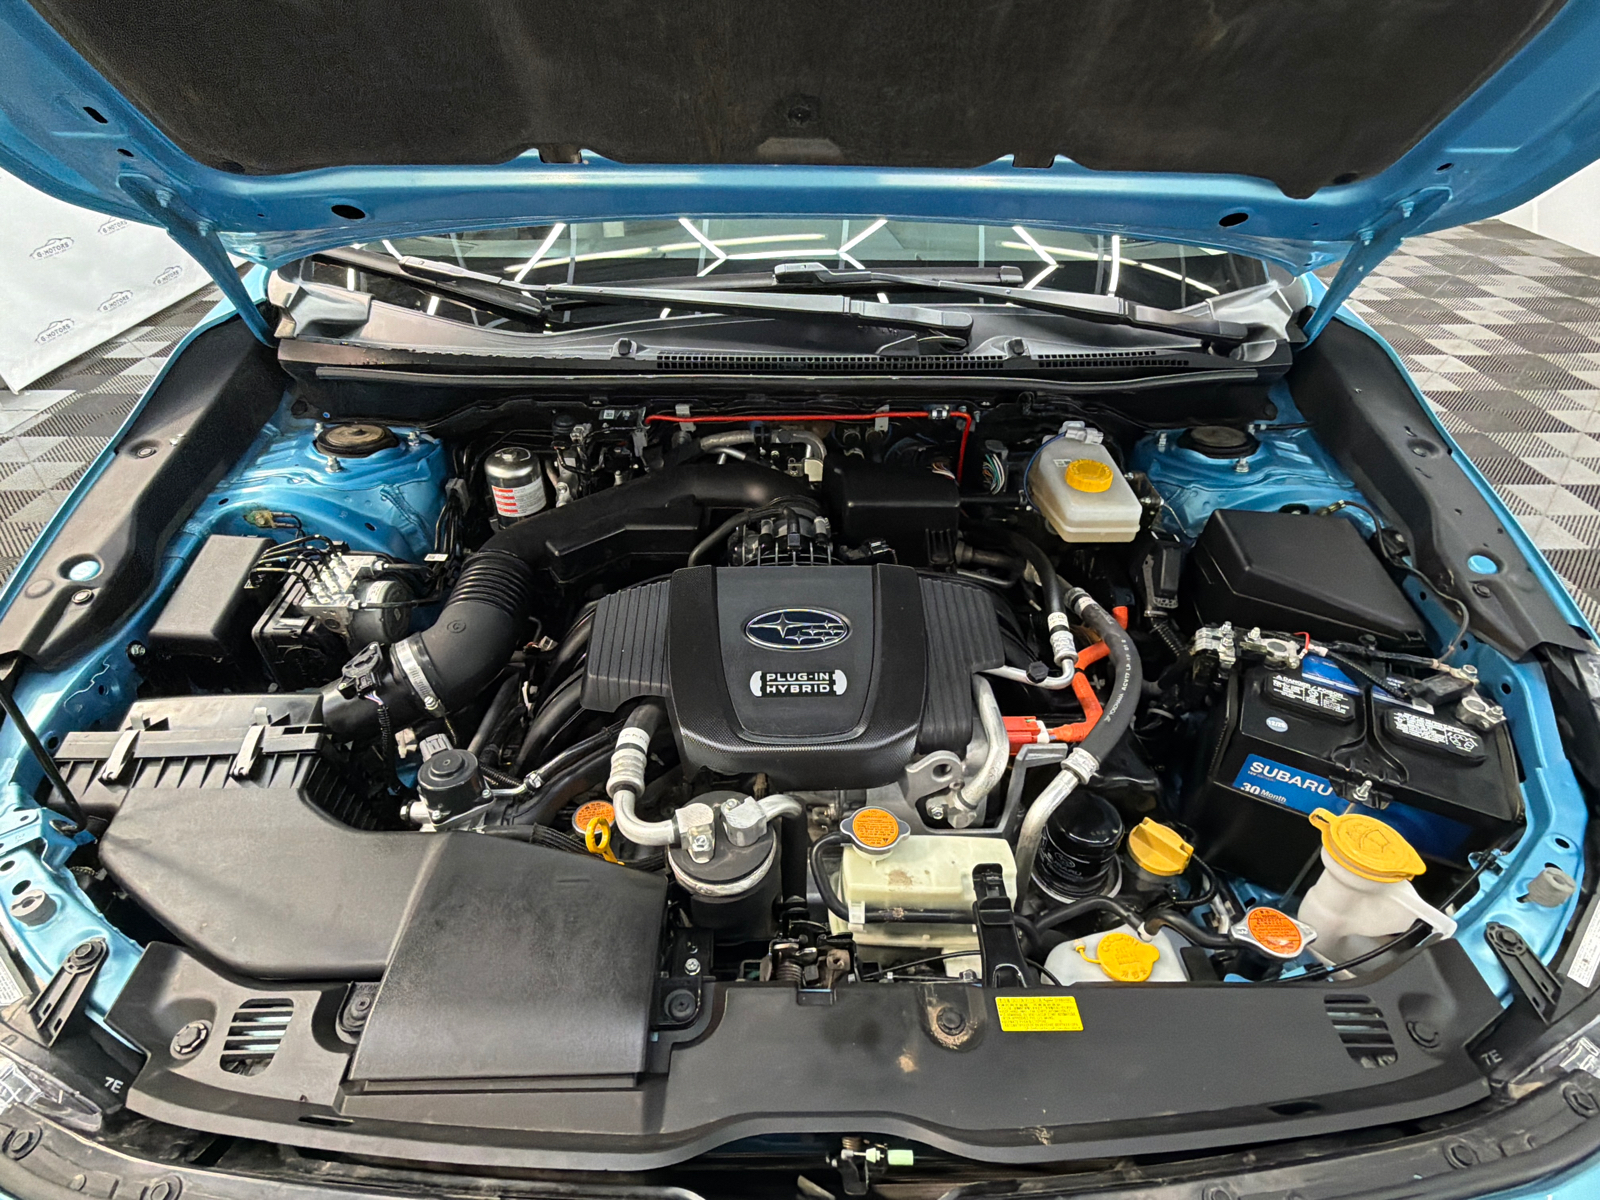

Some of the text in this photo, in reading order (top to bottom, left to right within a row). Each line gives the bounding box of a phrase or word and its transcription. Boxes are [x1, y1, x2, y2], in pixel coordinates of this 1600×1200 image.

[766, 672, 830, 682] PLUG-IN
[766, 684, 830, 694] HYBRID
[1249, 761, 1334, 796] SUBARU
[1240, 782, 1287, 803] 30 Month
[1480, 1049, 1503, 1066] 7E
[104, 1076, 124, 1094] 7E
